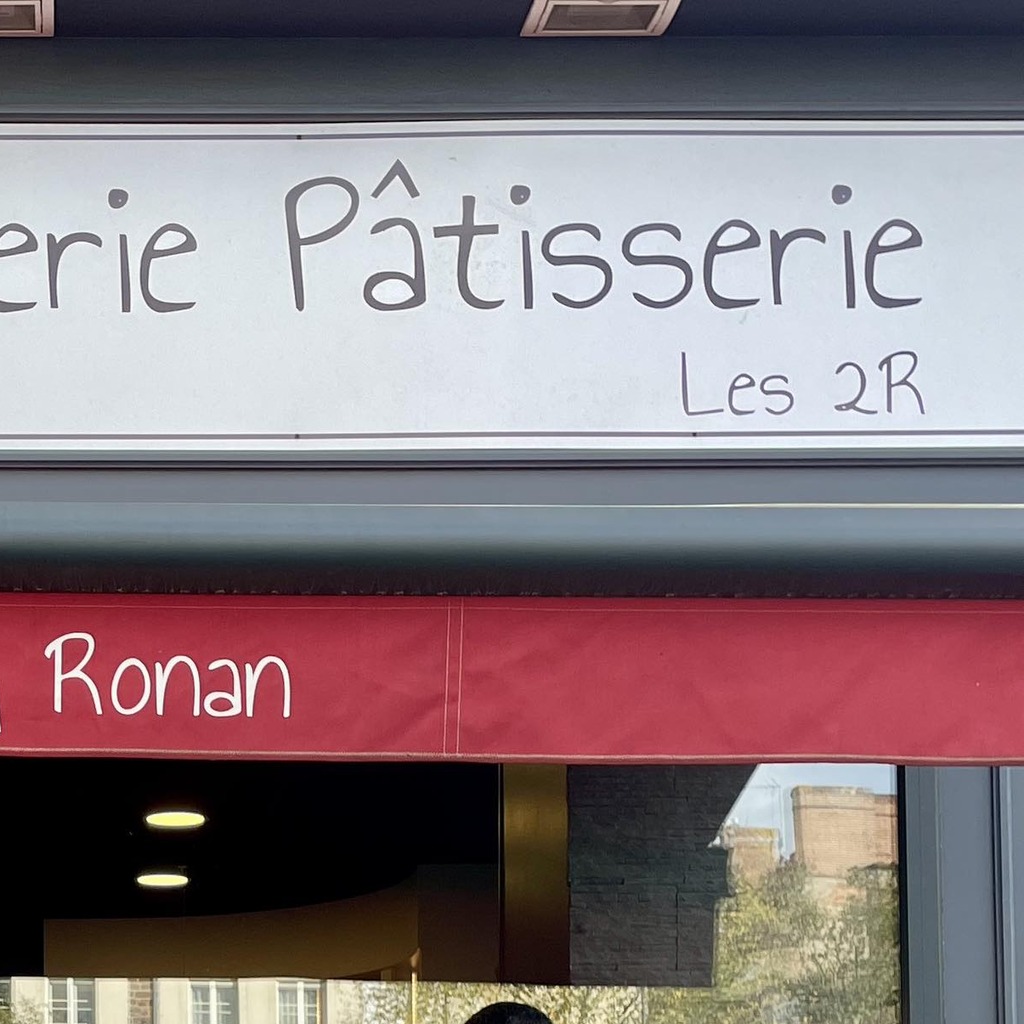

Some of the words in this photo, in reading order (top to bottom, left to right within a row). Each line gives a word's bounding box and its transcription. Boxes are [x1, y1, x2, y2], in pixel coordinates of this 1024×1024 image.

[284, 158, 923, 313] Pâtisserie
[681, 351, 794, 416] Les
[834, 350, 925, 416] 2R
[44, 632, 291, 718] Ronan
